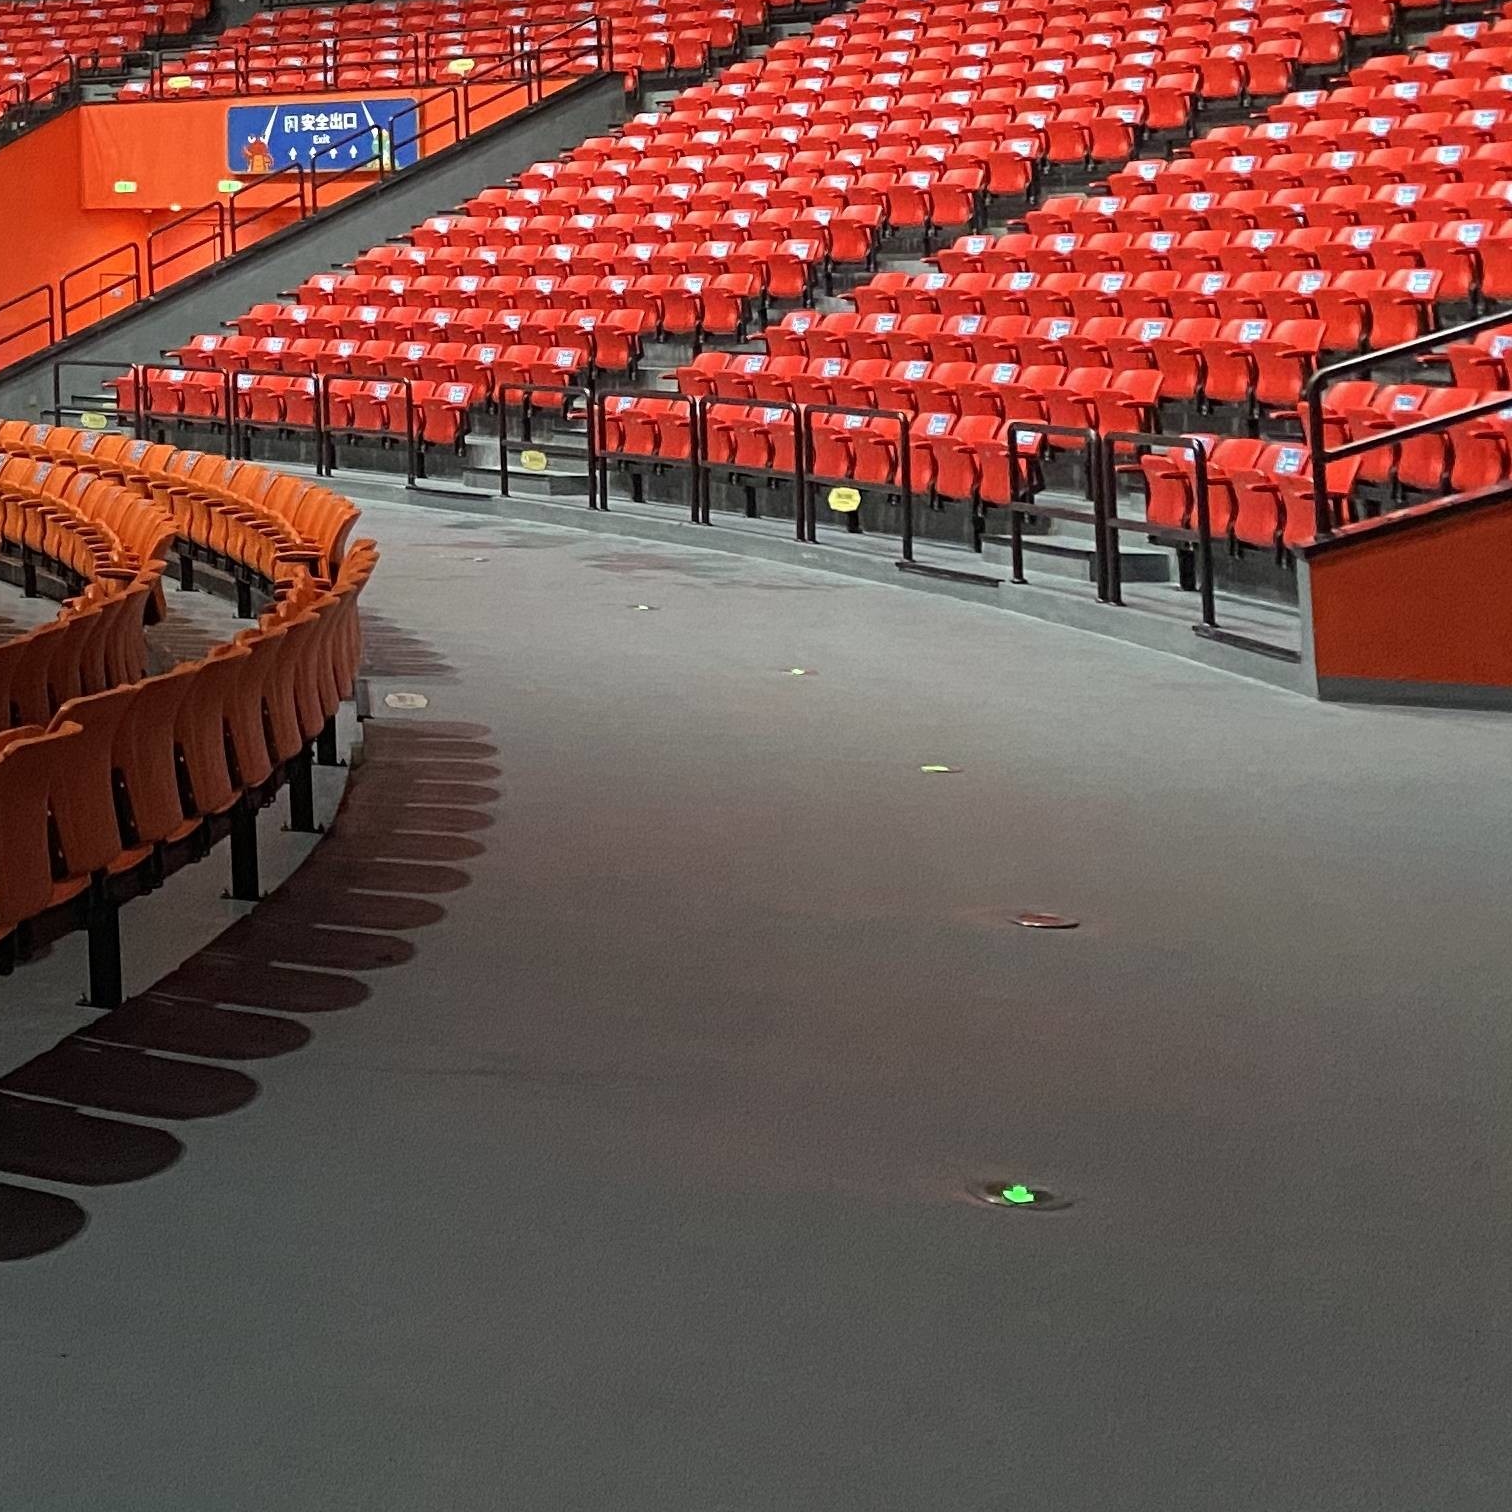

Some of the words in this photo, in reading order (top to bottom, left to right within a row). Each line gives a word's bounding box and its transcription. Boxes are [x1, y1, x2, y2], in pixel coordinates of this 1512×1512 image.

[301, 112, 357, 131] 安全出口
[313, 134, 331, 144] Exit
